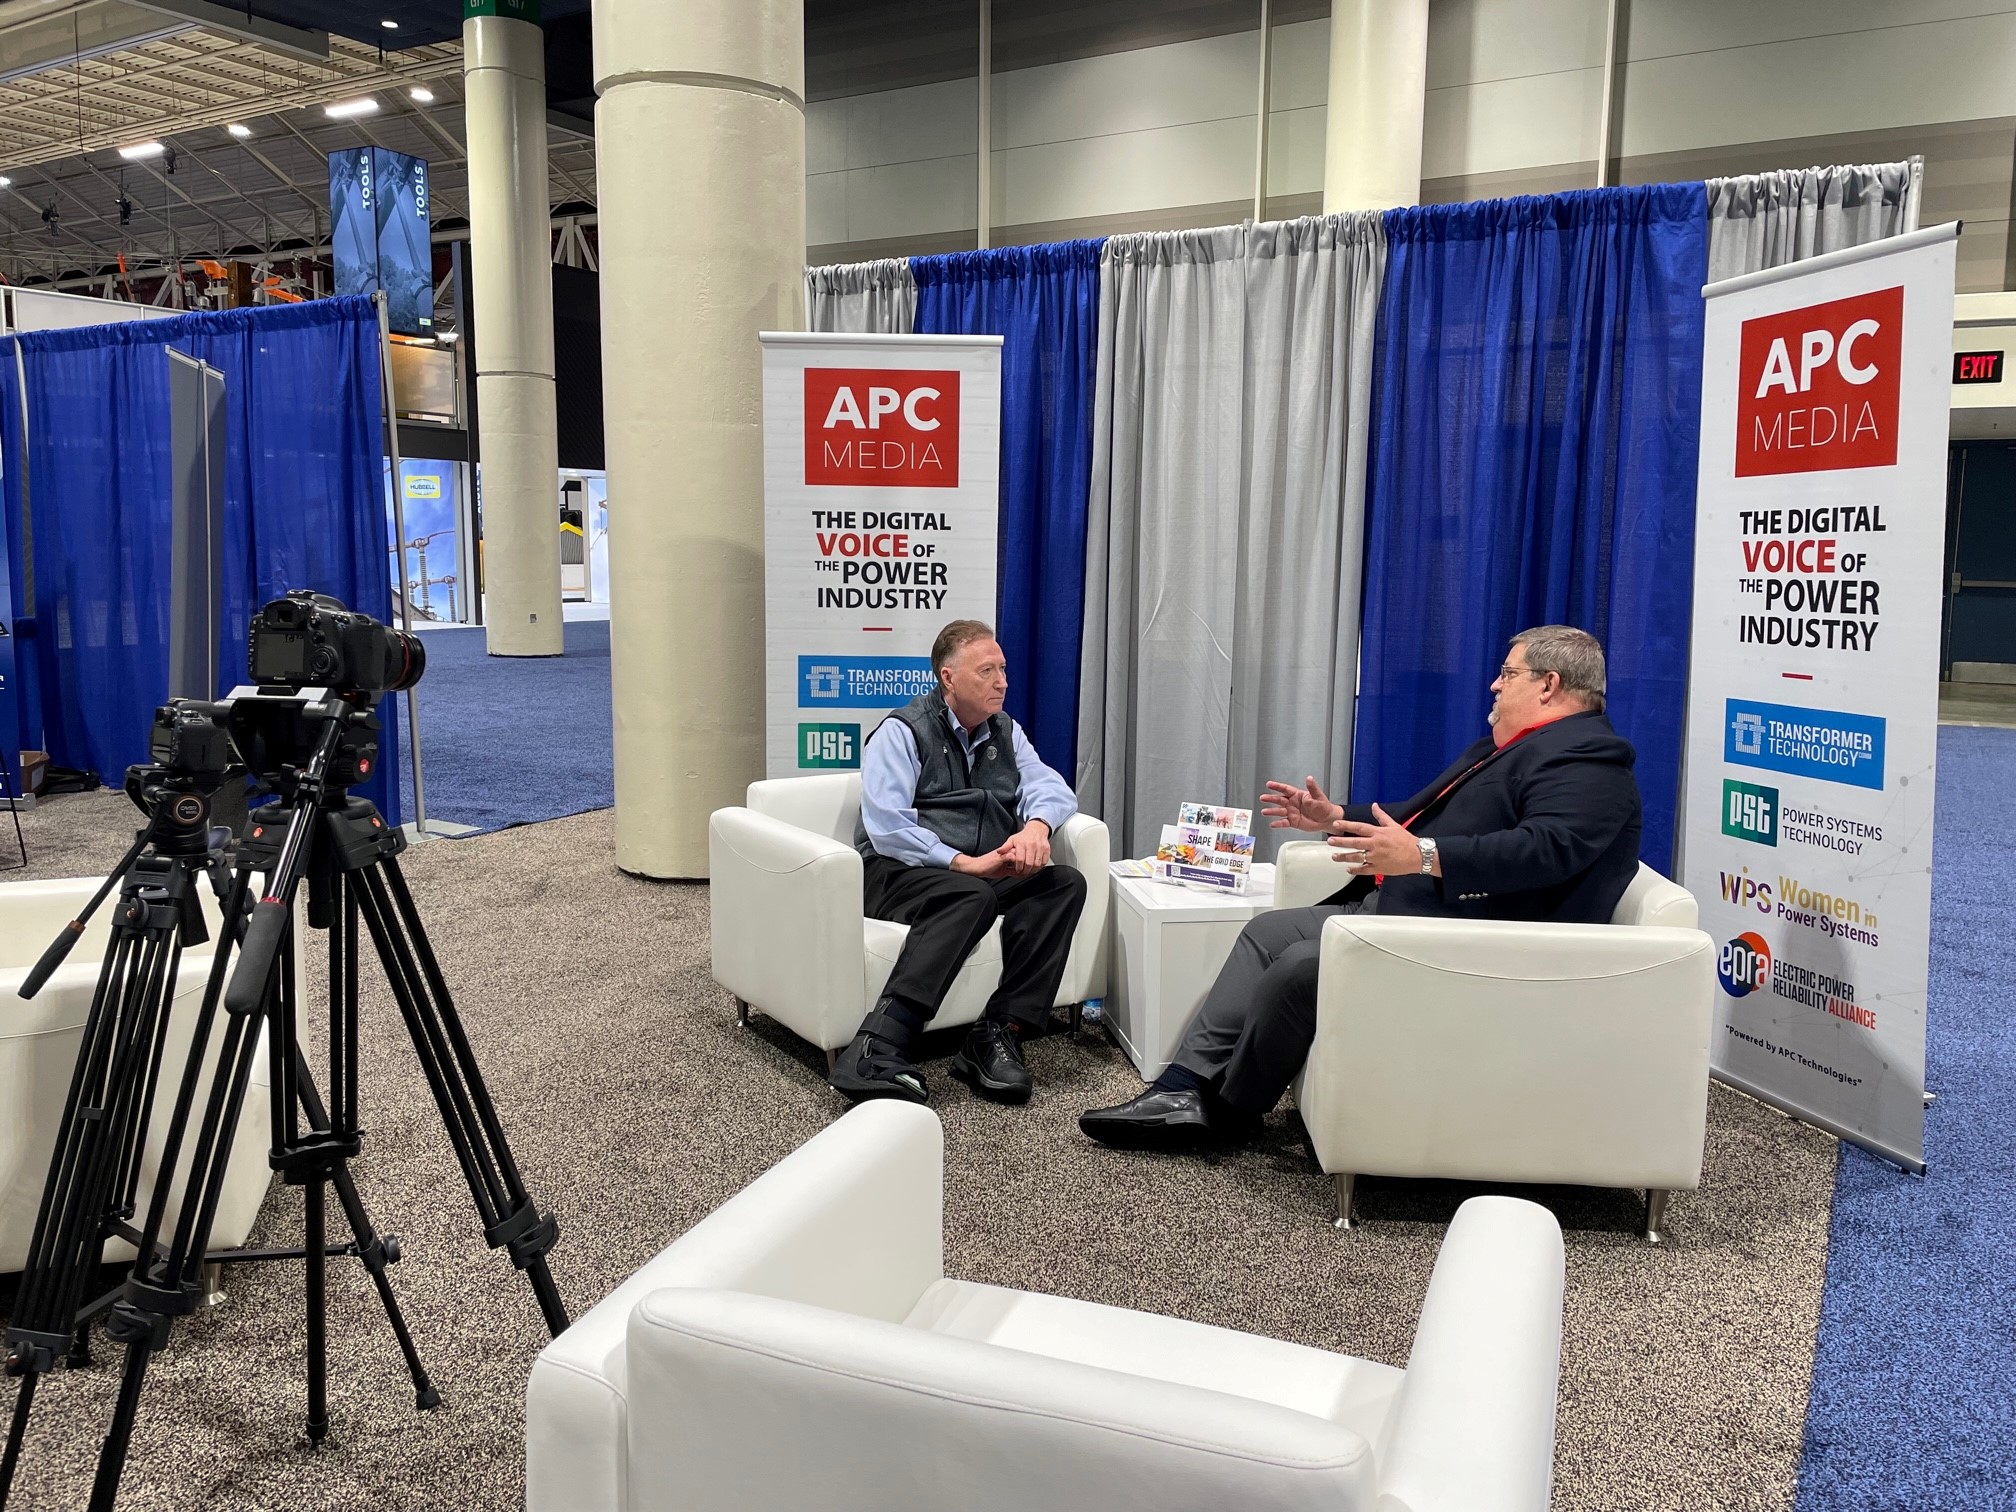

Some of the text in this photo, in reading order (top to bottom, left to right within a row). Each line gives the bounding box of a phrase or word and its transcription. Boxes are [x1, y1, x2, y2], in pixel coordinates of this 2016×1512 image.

[360, 155, 371, 209] TOOLS
[415, 166, 425, 217] TOOLS
[1755, 319, 1881, 399] APC
[1960, 355, 1998, 379] EXIT
[823, 386, 941, 431] APC
[1754, 401, 1880, 453] MEDIA
[823, 441, 943, 470] MEDIA
[812, 511, 952, 531] THE DIGITAL
[1740, 505, 1887, 535] THE DIGITAL
[816, 533, 935, 557] VOICE OF
[1742, 540, 1866, 573] VOICE OF
[814, 560, 948, 585] THE POWER
[817, 587, 948, 609] INDUSTRY
[1739, 578, 1880, 615] THE POWER
[1740, 615, 1879, 652] INDUSTRY
[847, 669, 939, 682] TRANSFORM
[1769, 720, 1872, 751] TRANSFORMER
[1768, 737, 1859, 767] TECHNOLOGY
[1782, 807, 1883, 841] POWER SYSTEMS
[1782, 825, 1863, 855] TECHNOLOGY
[1187, 834, 1212, 847] SHAPE
[1203, 855, 1214, 864] THE
[1229, 860, 1244, 869] EDGE
[1778, 875, 1878, 928] Women in
[1777, 902, 1879, 947] Power Systems
[1720, 942, 1769, 987] epra
[1773, 958, 1855, 1003] ELECTRIC POWER
[1773, 977, 1877, 1031] RELIABILITY ALLIANCE
[1766, 1040, 1776, 1054] by
[1778, 1046, 1796, 1061] APC
